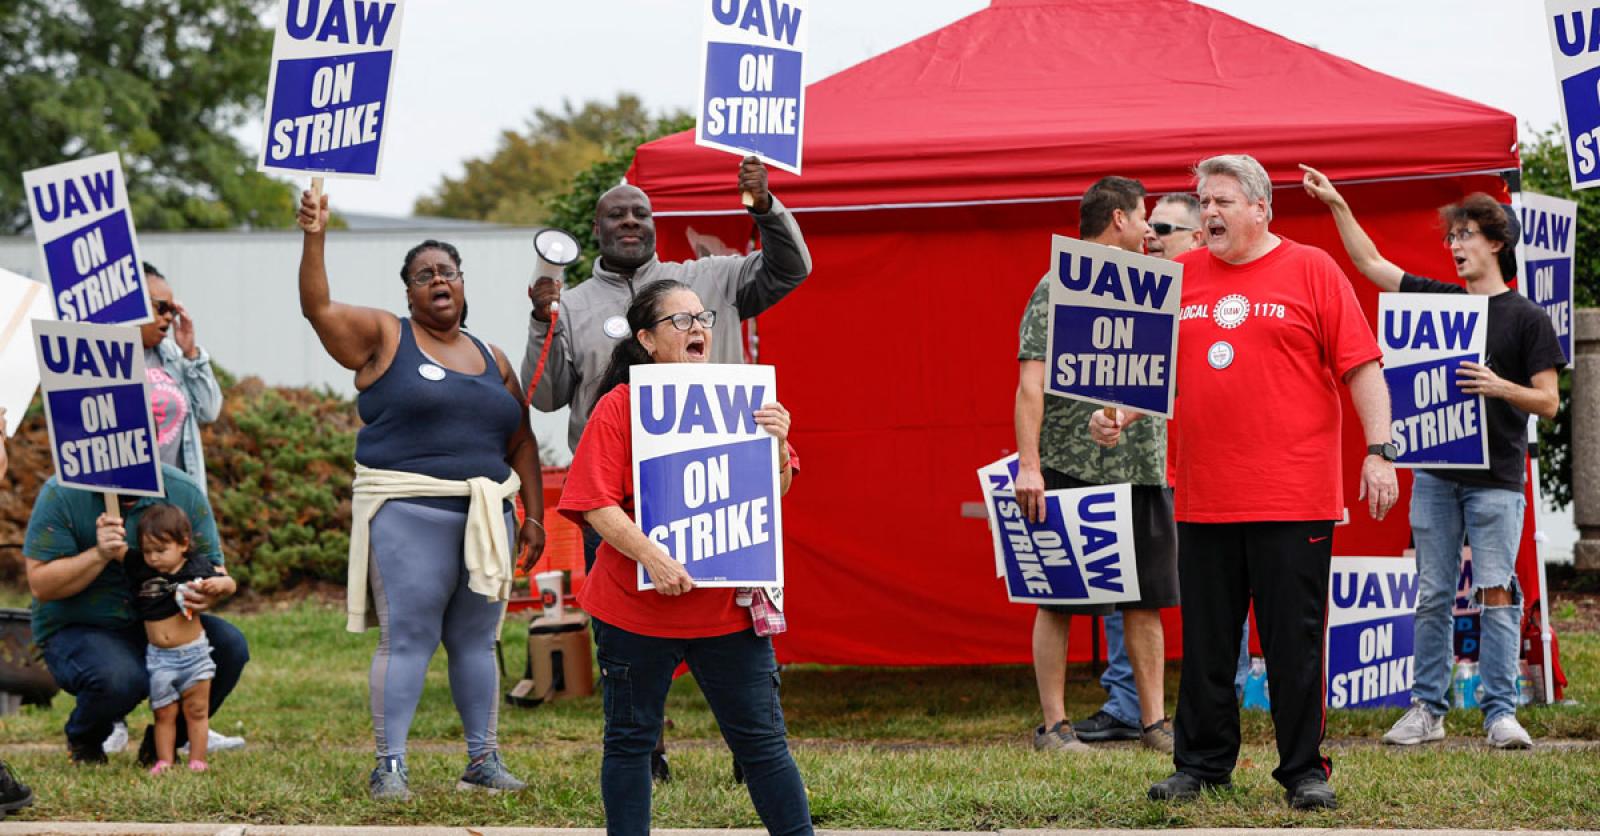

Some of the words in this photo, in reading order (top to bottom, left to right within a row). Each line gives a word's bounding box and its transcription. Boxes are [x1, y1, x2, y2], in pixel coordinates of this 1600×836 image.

[286, 0, 396, 46] UAW
[712, 0, 802, 46] UAW
[312, 61, 356, 109] ON
[739, 53, 774, 92] ON
[271, 101, 381, 161] STRIKE
[707, 96, 797, 136] STRIKE
[32, 169, 114, 223] UAW
[72, 227, 107, 276] ON
[1521, 207, 1572, 253] UAW
[58, 254, 139, 321] STRIKE
[1059, 251, 1173, 310] UAW
[1534, 265, 1554, 304] ON
[1092, 316, 1135, 350] ON
[1179, 303, 1208, 320] LOCAL
[1254, 303, 1285, 319] 1178
[1384, 310, 1479, 350] UAW
[39, 335, 134, 380] UAW
[1056, 352, 1165, 387] STRIKE
[639, 384, 766, 436] UAW
[1414, 365, 1448, 410] ON
[80, 392, 118, 434] ON
[1391, 398, 1478, 457] STRIKE
[61, 427, 151, 478] STRIKE
[683, 453, 730, 509] ON
[998, 499, 1054, 595] STRIKE
[1032, 530, 1072, 567] ON
[1077, 491, 1125, 593] UAW
[1332, 572, 1420, 609] UAW
[1359, 623, 1393, 664] ON
